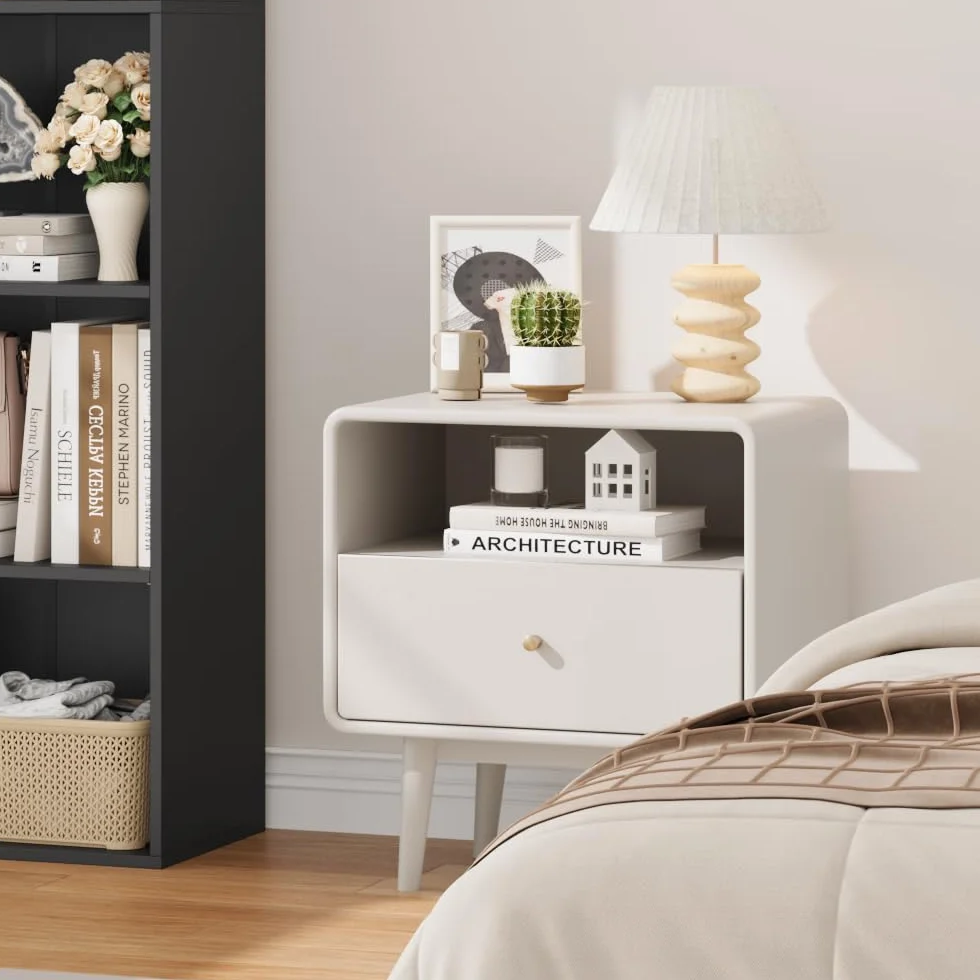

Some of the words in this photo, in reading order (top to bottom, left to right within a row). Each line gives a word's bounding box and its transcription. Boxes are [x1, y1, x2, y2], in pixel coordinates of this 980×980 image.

[118, 383, 130, 439] MARINO
[26, 407, 43, 445] Isamu
[23, 448, 40, 504] Noguchi
[57, 430, 73, 502] SCHIELE
[118, 442, 130, 505] STEPHEN
[495, 515, 518, 527] HOME
[520, 517, 547, 528] HOUSE
[550, 518, 567, 529] THE
[568, 519, 608, 531] BRINGING
[471, 536, 642, 556] ARCHITECTURE
